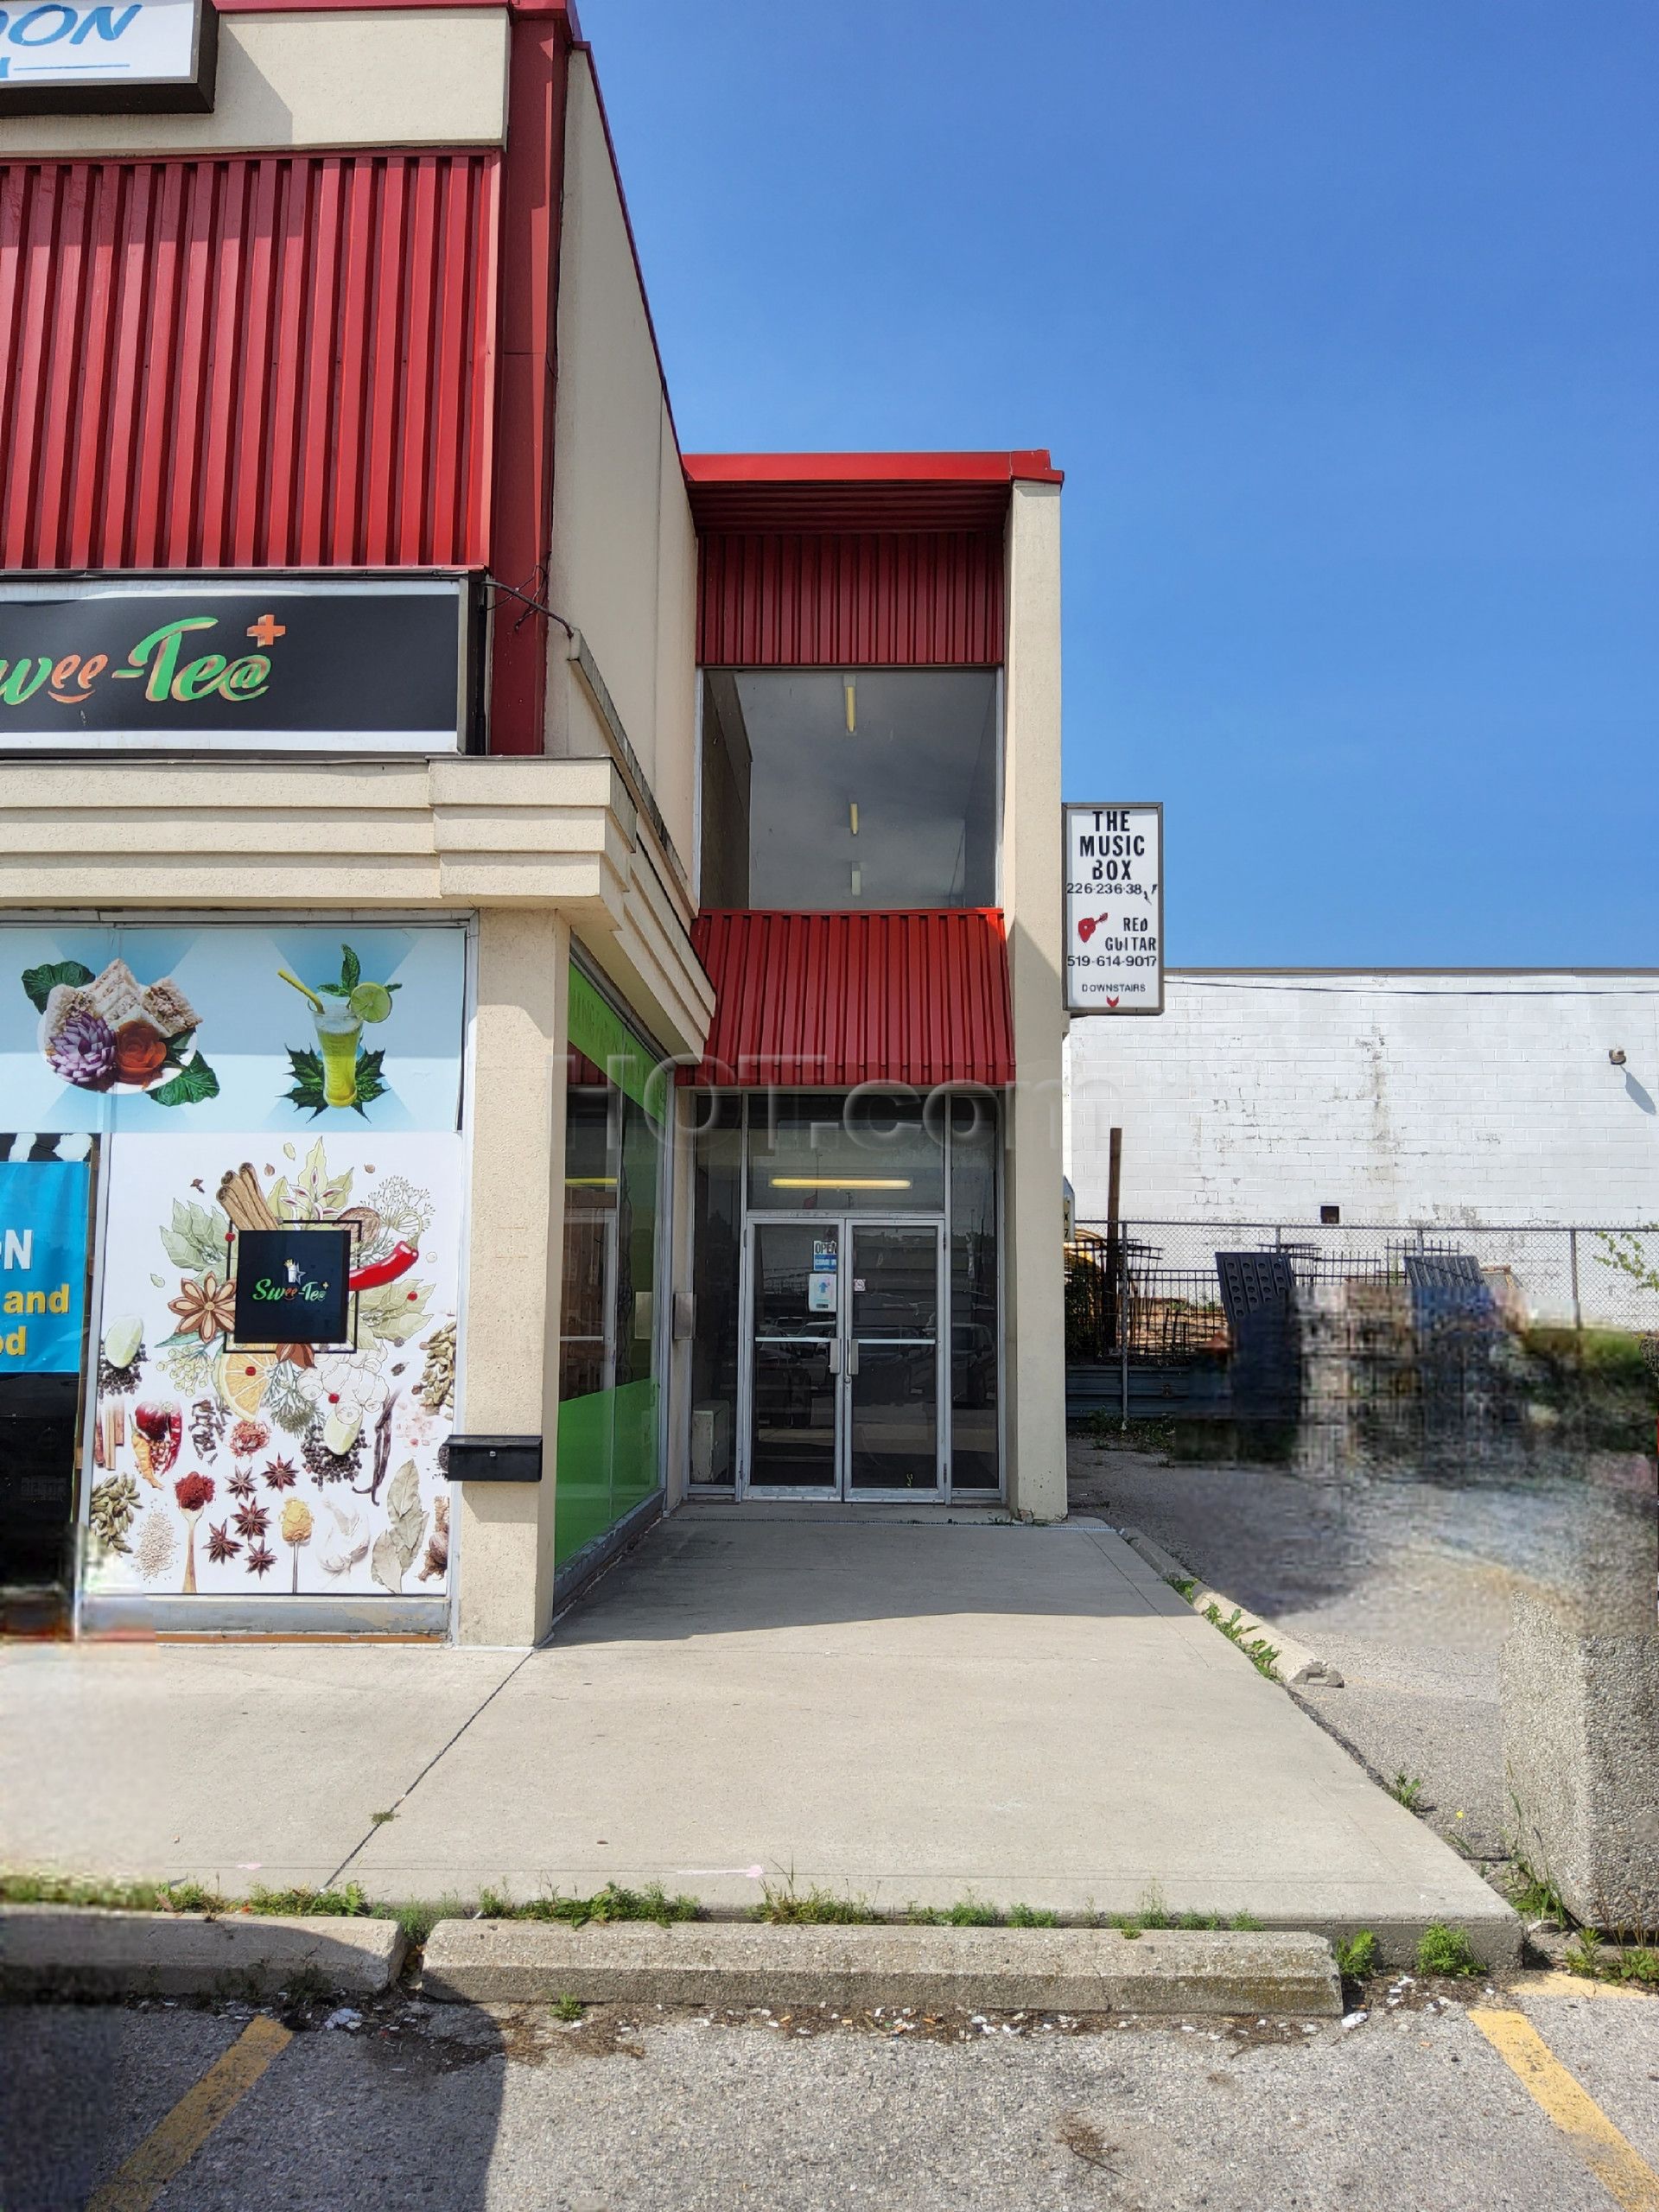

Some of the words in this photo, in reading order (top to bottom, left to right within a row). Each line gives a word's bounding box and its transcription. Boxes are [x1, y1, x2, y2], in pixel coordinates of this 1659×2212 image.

[0, 4, 143, 46] ON
[1092, 810, 1130, 831] THE
[1080, 835, 1145, 856] MUSIC
[1092, 859, 1132, 880] BOX
[1123, 917, 1148, 931] RED
[1105, 937, 1156, 951] GUITAR
[1067, 955, 1157, 967] 519-614-9017
[1082, 983, 1146, 993] DOWNSTAIRS
[3, 1283, 69, 1314] and
